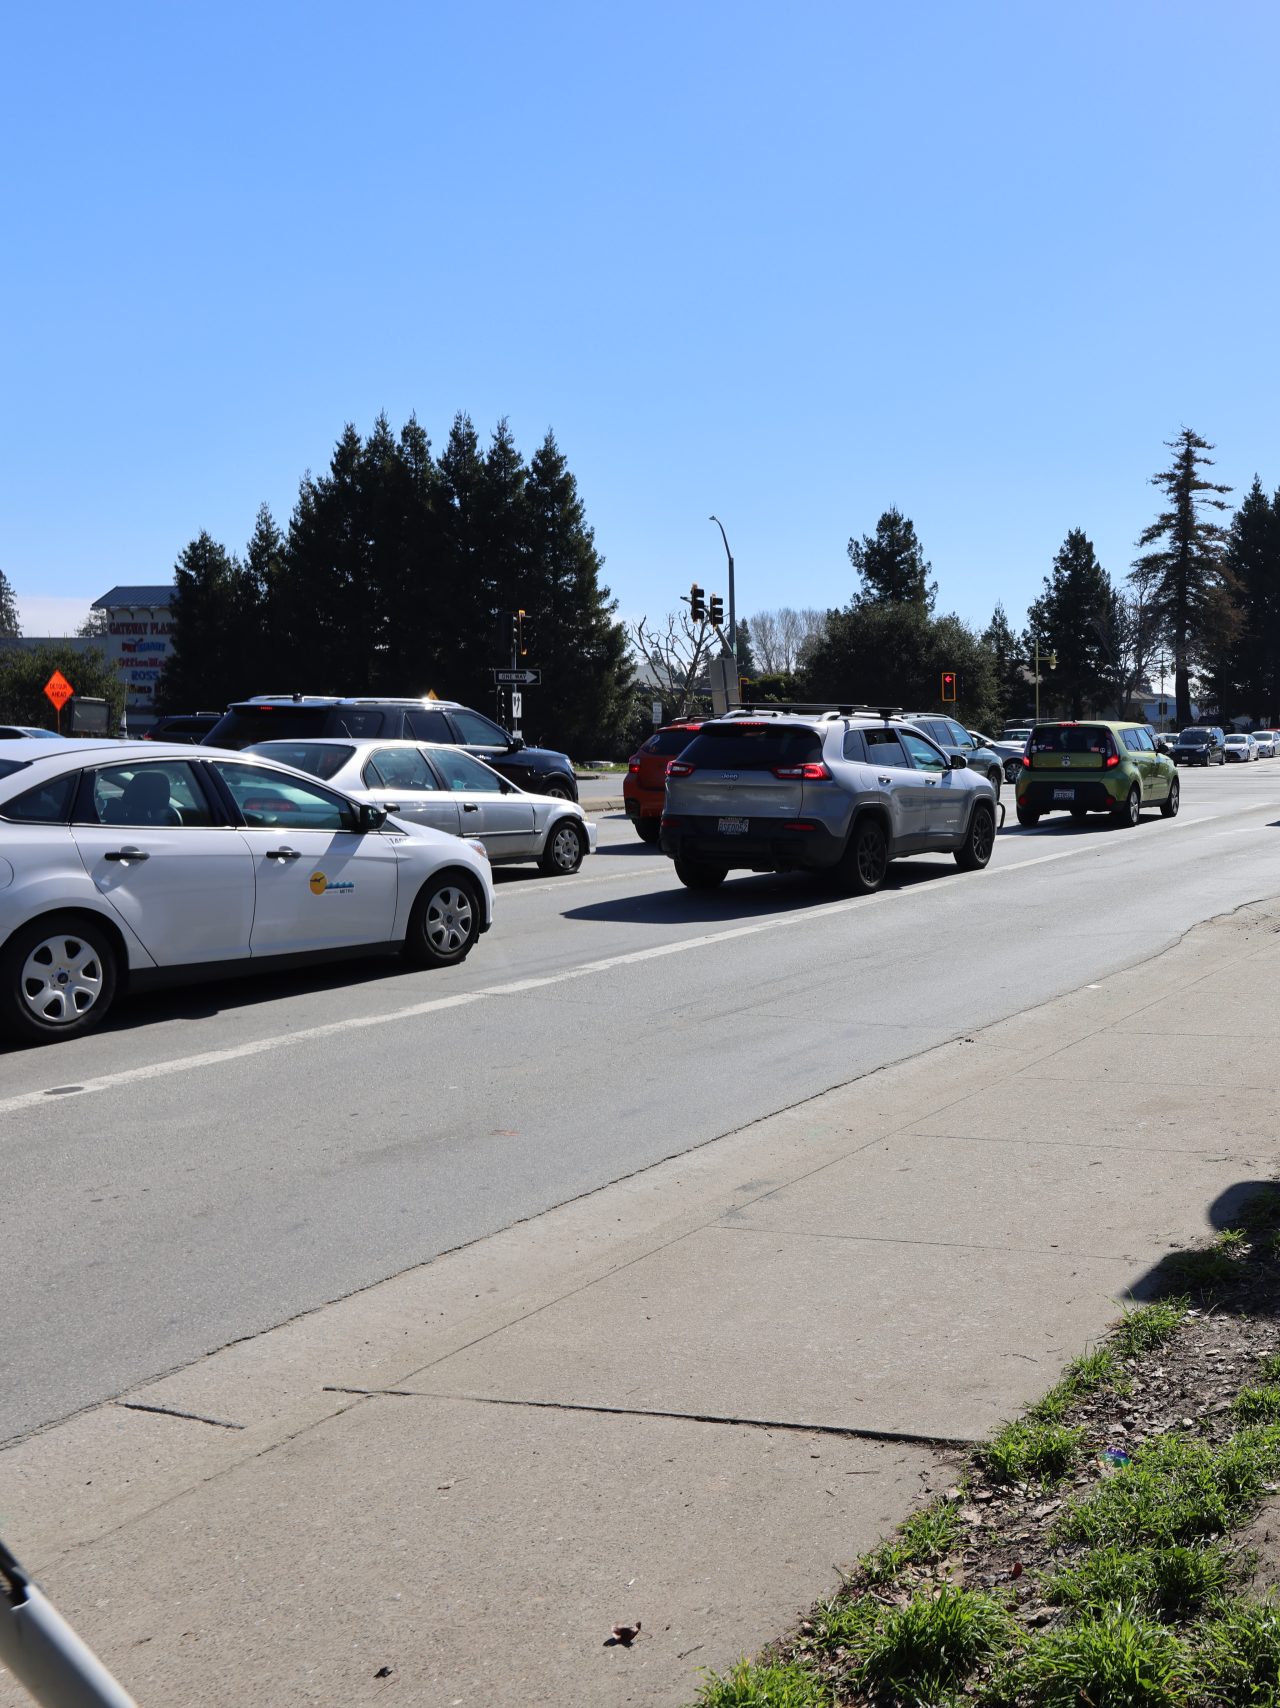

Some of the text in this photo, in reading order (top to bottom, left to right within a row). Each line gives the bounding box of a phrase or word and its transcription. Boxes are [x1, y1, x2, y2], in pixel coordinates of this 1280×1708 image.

[109, 622, 147, 635] GATEWAY
[131, 670, 159, 681] ROSS
[721, 773, 738, 781] Jeep
